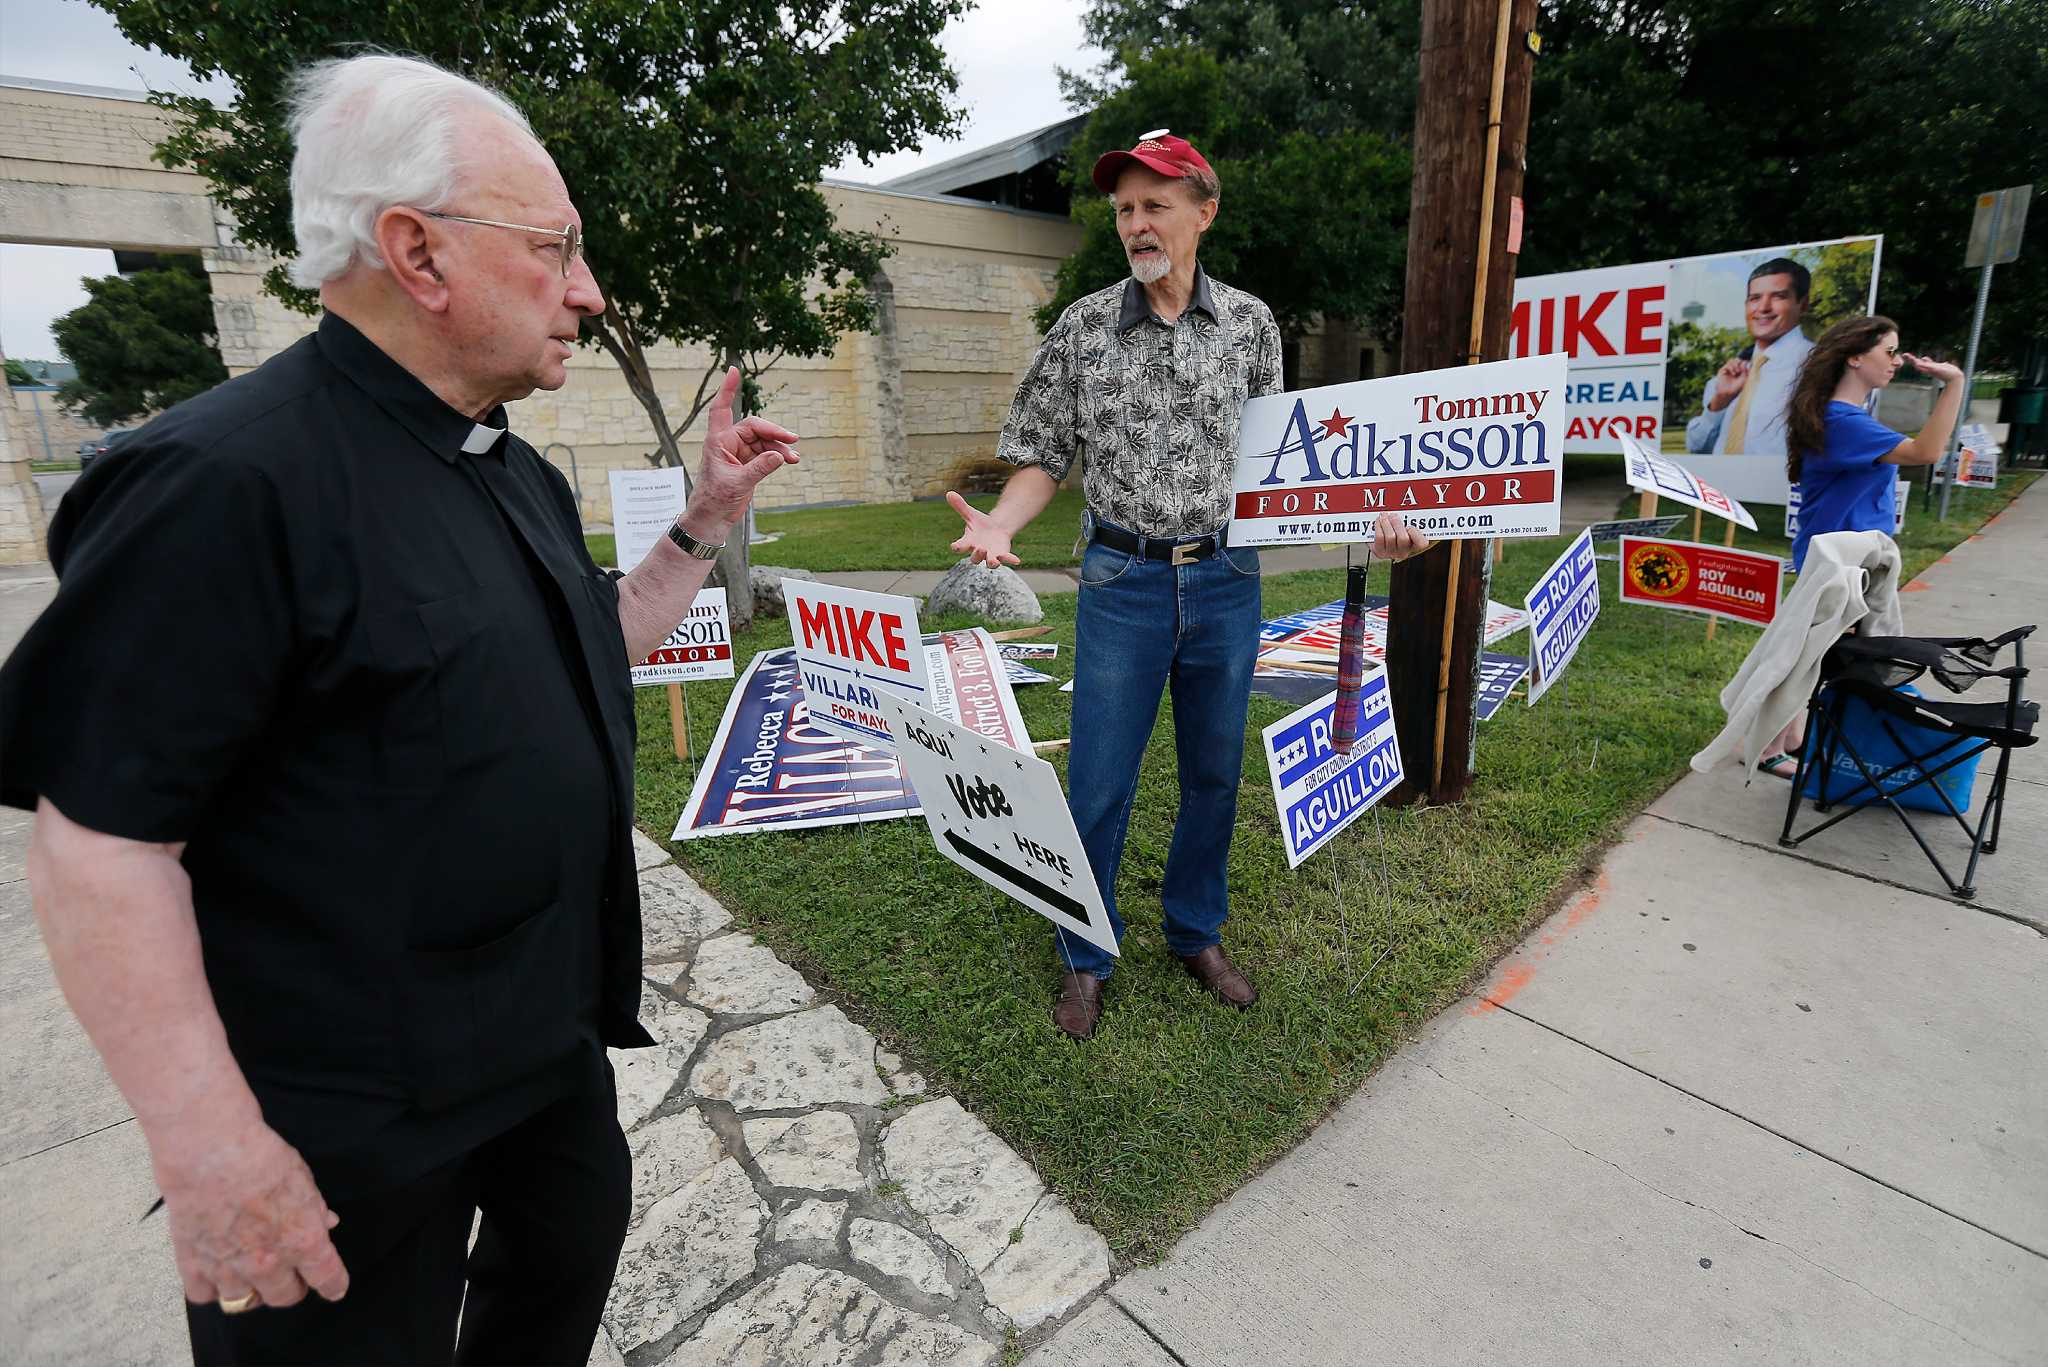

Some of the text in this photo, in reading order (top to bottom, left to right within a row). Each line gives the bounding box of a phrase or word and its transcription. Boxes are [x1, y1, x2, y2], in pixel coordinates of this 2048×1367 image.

[1414, 389, 1550, 424] Tommy
[1565, 415, 1658, 440] AYOR
[1257, 478, 1523, 516] FOR MAYOR
[1277, 514, 1494, 536] www.tommyisson.com
[1548, 558, 1576, 610] ROY
[1698, 568, 1728, 583] ROY
[1698, 581, 1766, 604] AGUILLON
[796, 597, 912, 674] MIKE
[1544, 585, 1600, 678] AGUILLON
[831, 703, 857, 723] FOR
[858, 711, 893, 734] MAY
[964, 692, 1010, 747] istrict
[734, 709, 785, 790] Rebecca
[945, 773, 1014, 820] Vote
[1295, 740, 1399, 850] AGUILLON
[1304, 773, 1318, 793] FOR
[1316, 763, 1330, 784] CITY
[1013, 831, 1074, 880] HERE
